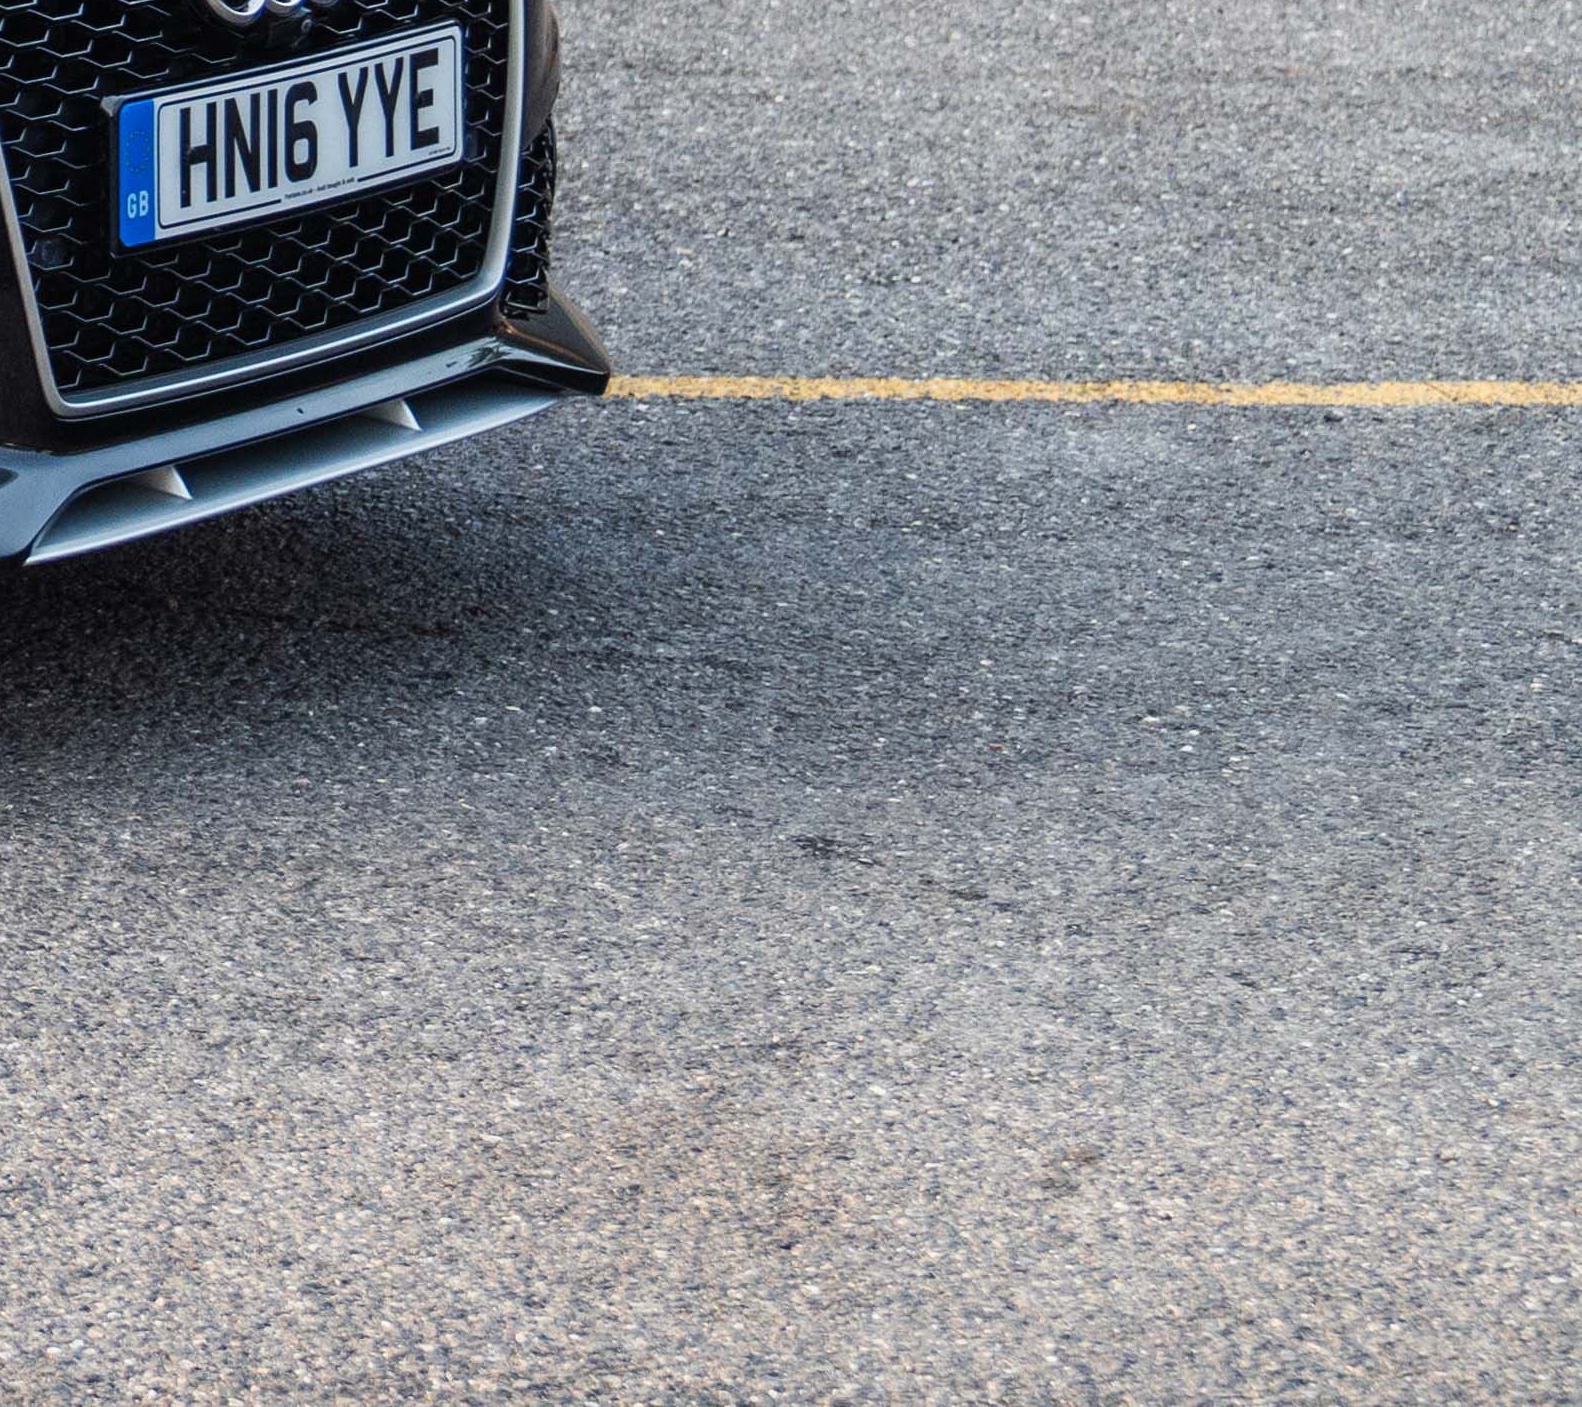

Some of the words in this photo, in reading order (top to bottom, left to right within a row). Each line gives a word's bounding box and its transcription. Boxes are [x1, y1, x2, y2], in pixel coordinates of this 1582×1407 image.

[179, 80, 319, 209] HN16
[339, 47, 441, 168] YYE
[127, 190, 149, 218] GB
